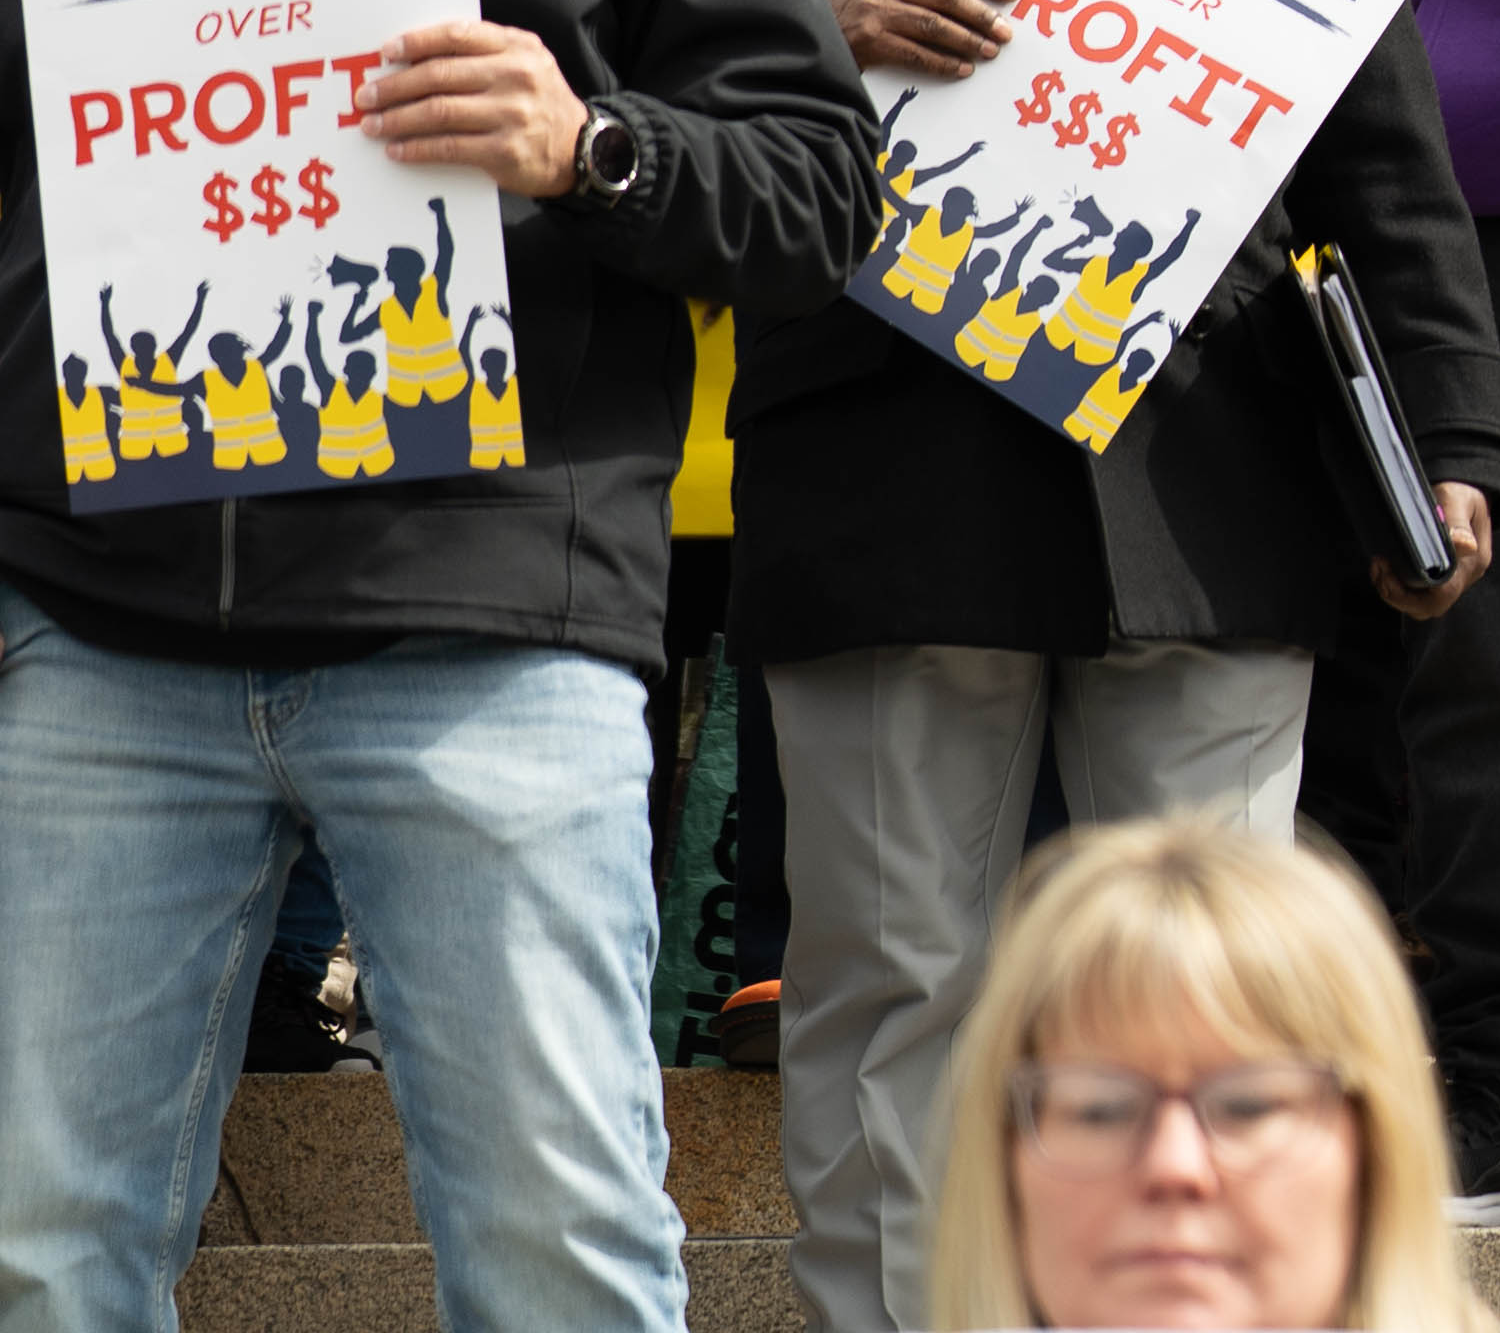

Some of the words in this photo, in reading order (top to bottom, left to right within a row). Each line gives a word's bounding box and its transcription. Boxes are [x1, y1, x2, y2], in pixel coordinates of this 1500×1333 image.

[194, 0, 313, 45] OVER
[69, 50, 398, 166] PROFI
[1014, 70, 1141, 170] $$$
[203, 158, 341, 244] $$$
